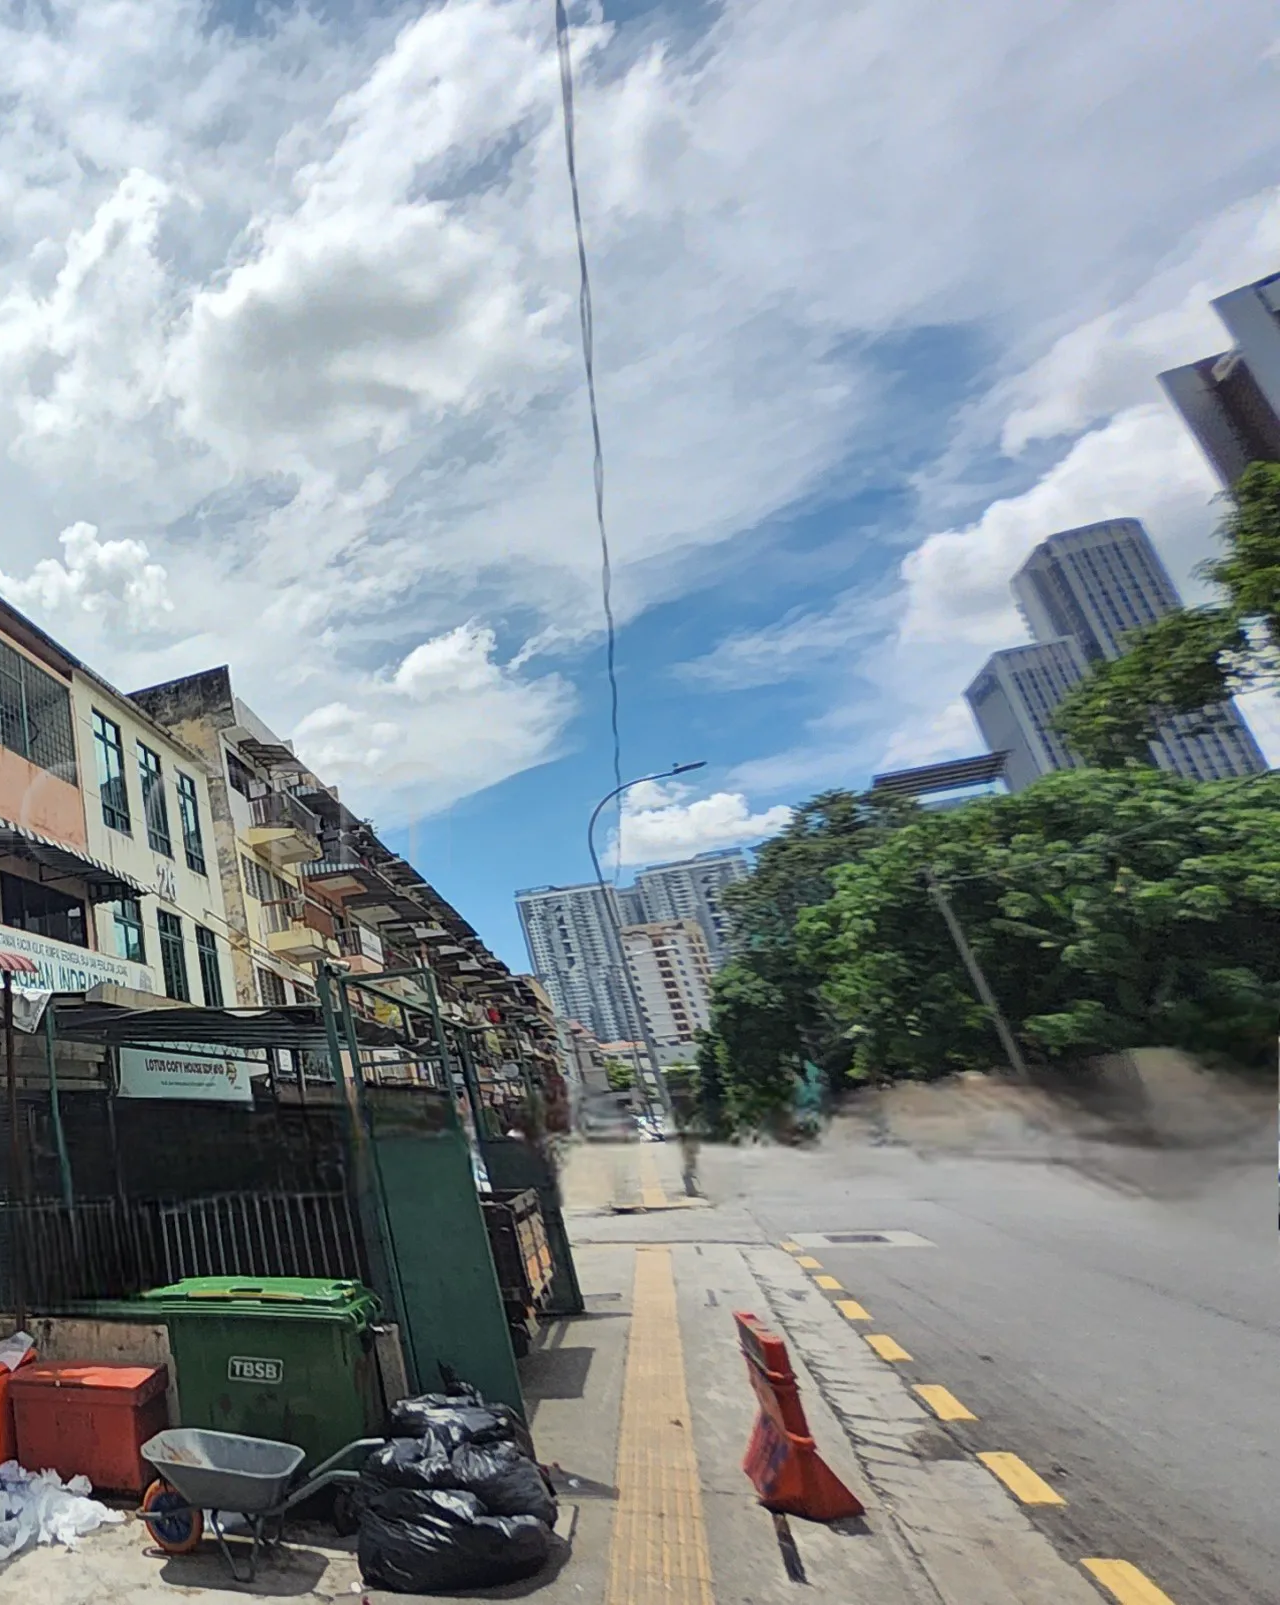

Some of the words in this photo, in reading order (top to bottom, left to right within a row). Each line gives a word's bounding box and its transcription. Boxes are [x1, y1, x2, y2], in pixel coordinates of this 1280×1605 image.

[59, 964, 126, 991] INDRAP
[145, 1058, 166, 1072] LOTUS
[232, 1359, 277, 1379] TBSB
